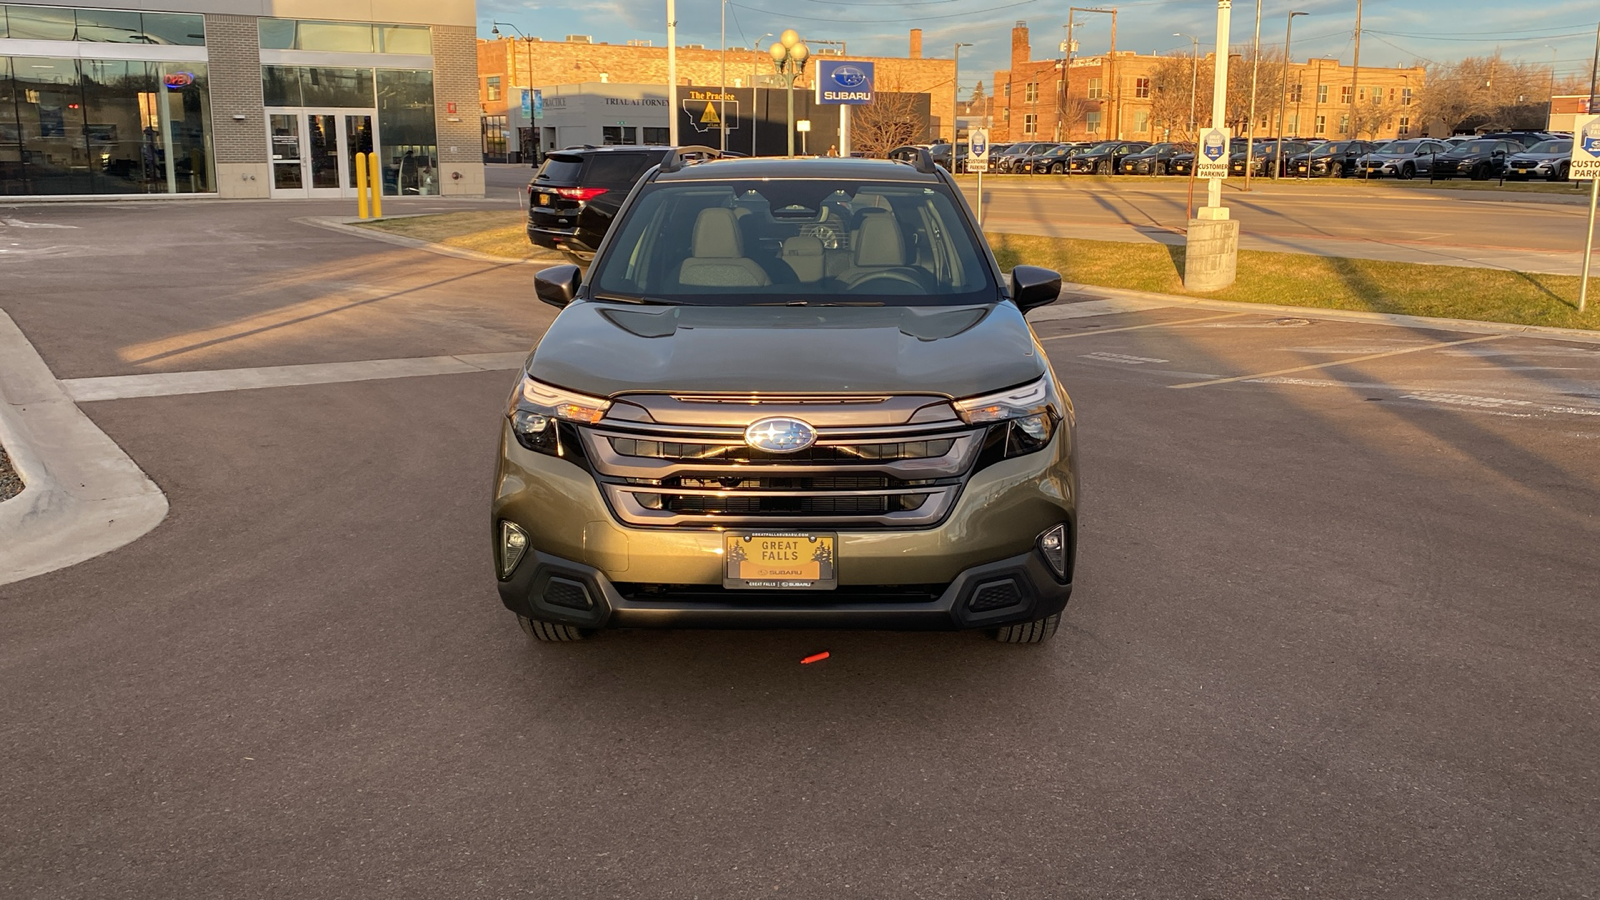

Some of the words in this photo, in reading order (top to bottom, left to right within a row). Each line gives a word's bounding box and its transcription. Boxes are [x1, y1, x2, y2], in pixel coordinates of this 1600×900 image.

[163, 74, 191, 85] OPEN
[690, 91, 705, 99] The
[706, 92, 735, 100] Pracice
[824, 91, 871, 100] SUBARU
[543, 97, 566, 107] PRACTICE
[605, 98, 629, 106] TRIAL
[762, 541, 799, 550] GREAT
[762, 551, 799, 561] FALLS
